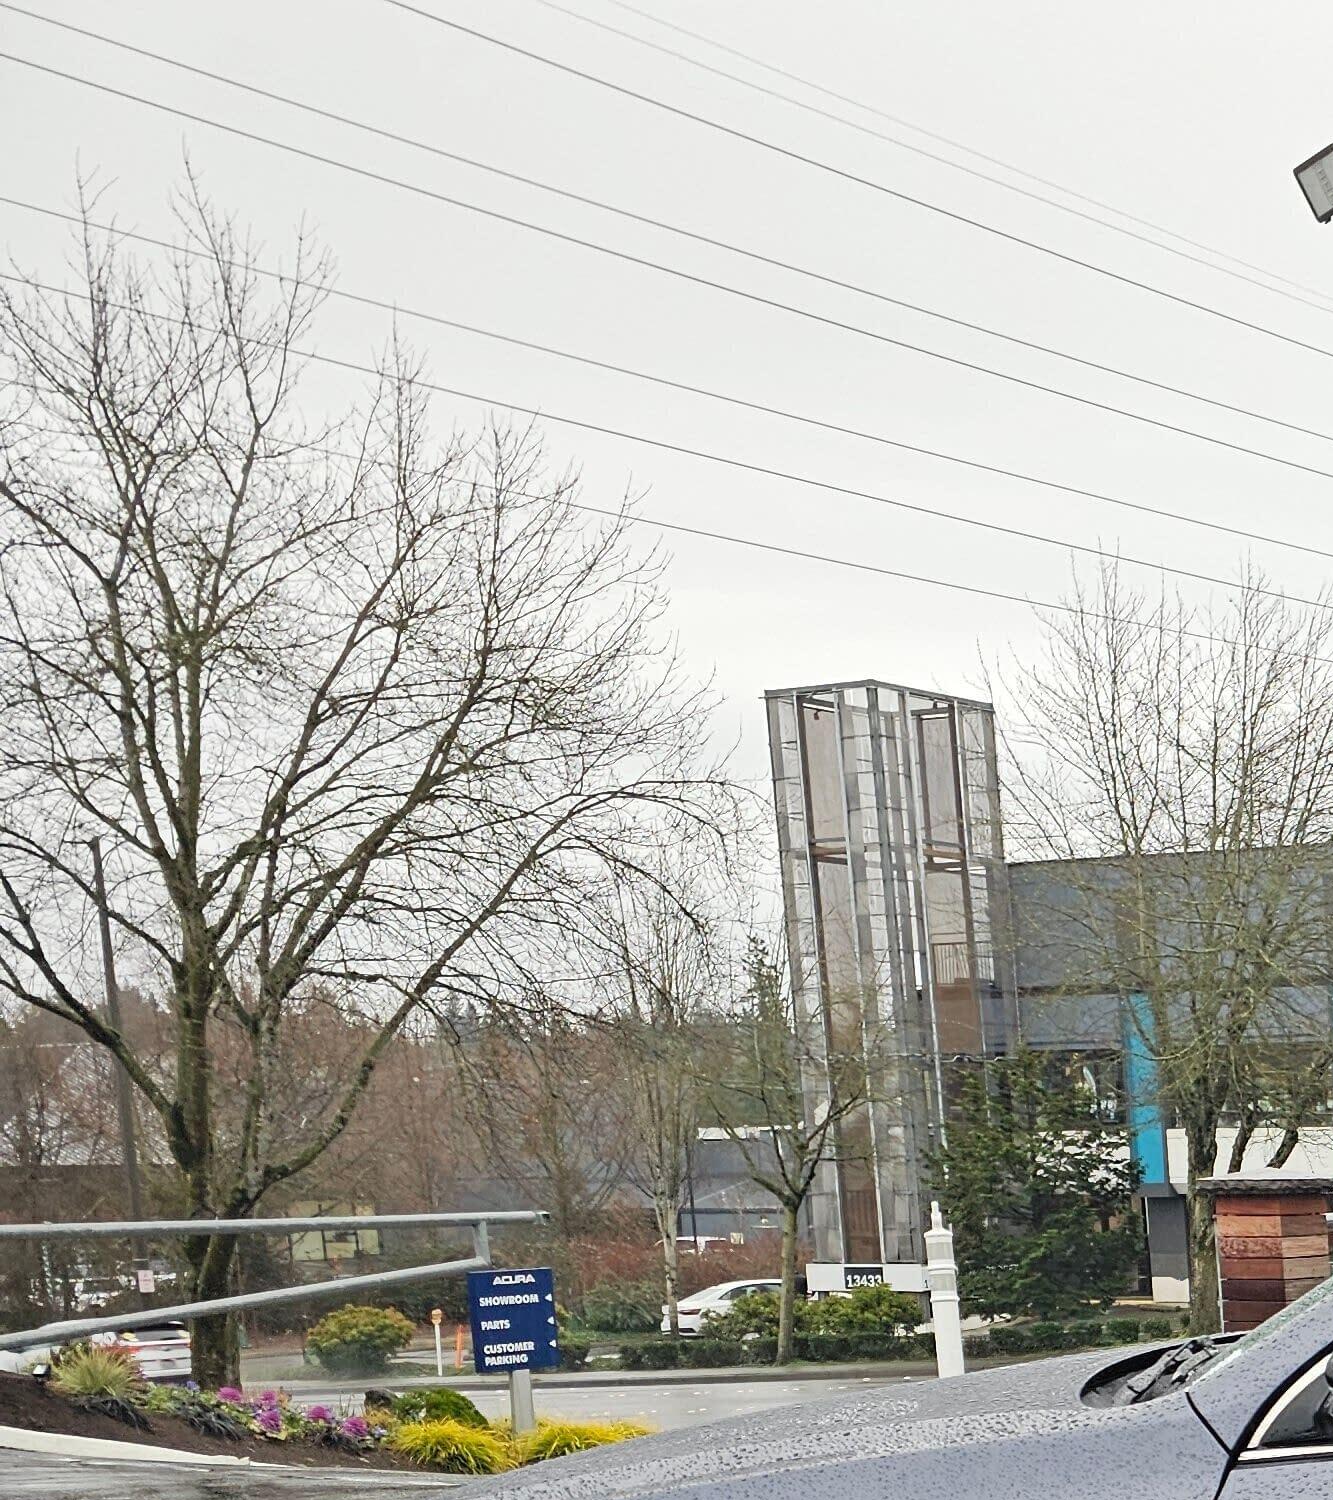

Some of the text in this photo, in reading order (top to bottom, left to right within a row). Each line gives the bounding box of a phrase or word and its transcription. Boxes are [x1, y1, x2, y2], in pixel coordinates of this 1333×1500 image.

[493, 1274, 535, 1285] ACURA
[847, 1275, 882, 1287] 13433
[479, 1294, 540, 1307] SHOWROOM
[481, 1320, 510, 1330] PARTS
[483, 1341, 535, 1354] CUSTOMER
[485, 1354, 528, 1366] PARKING
